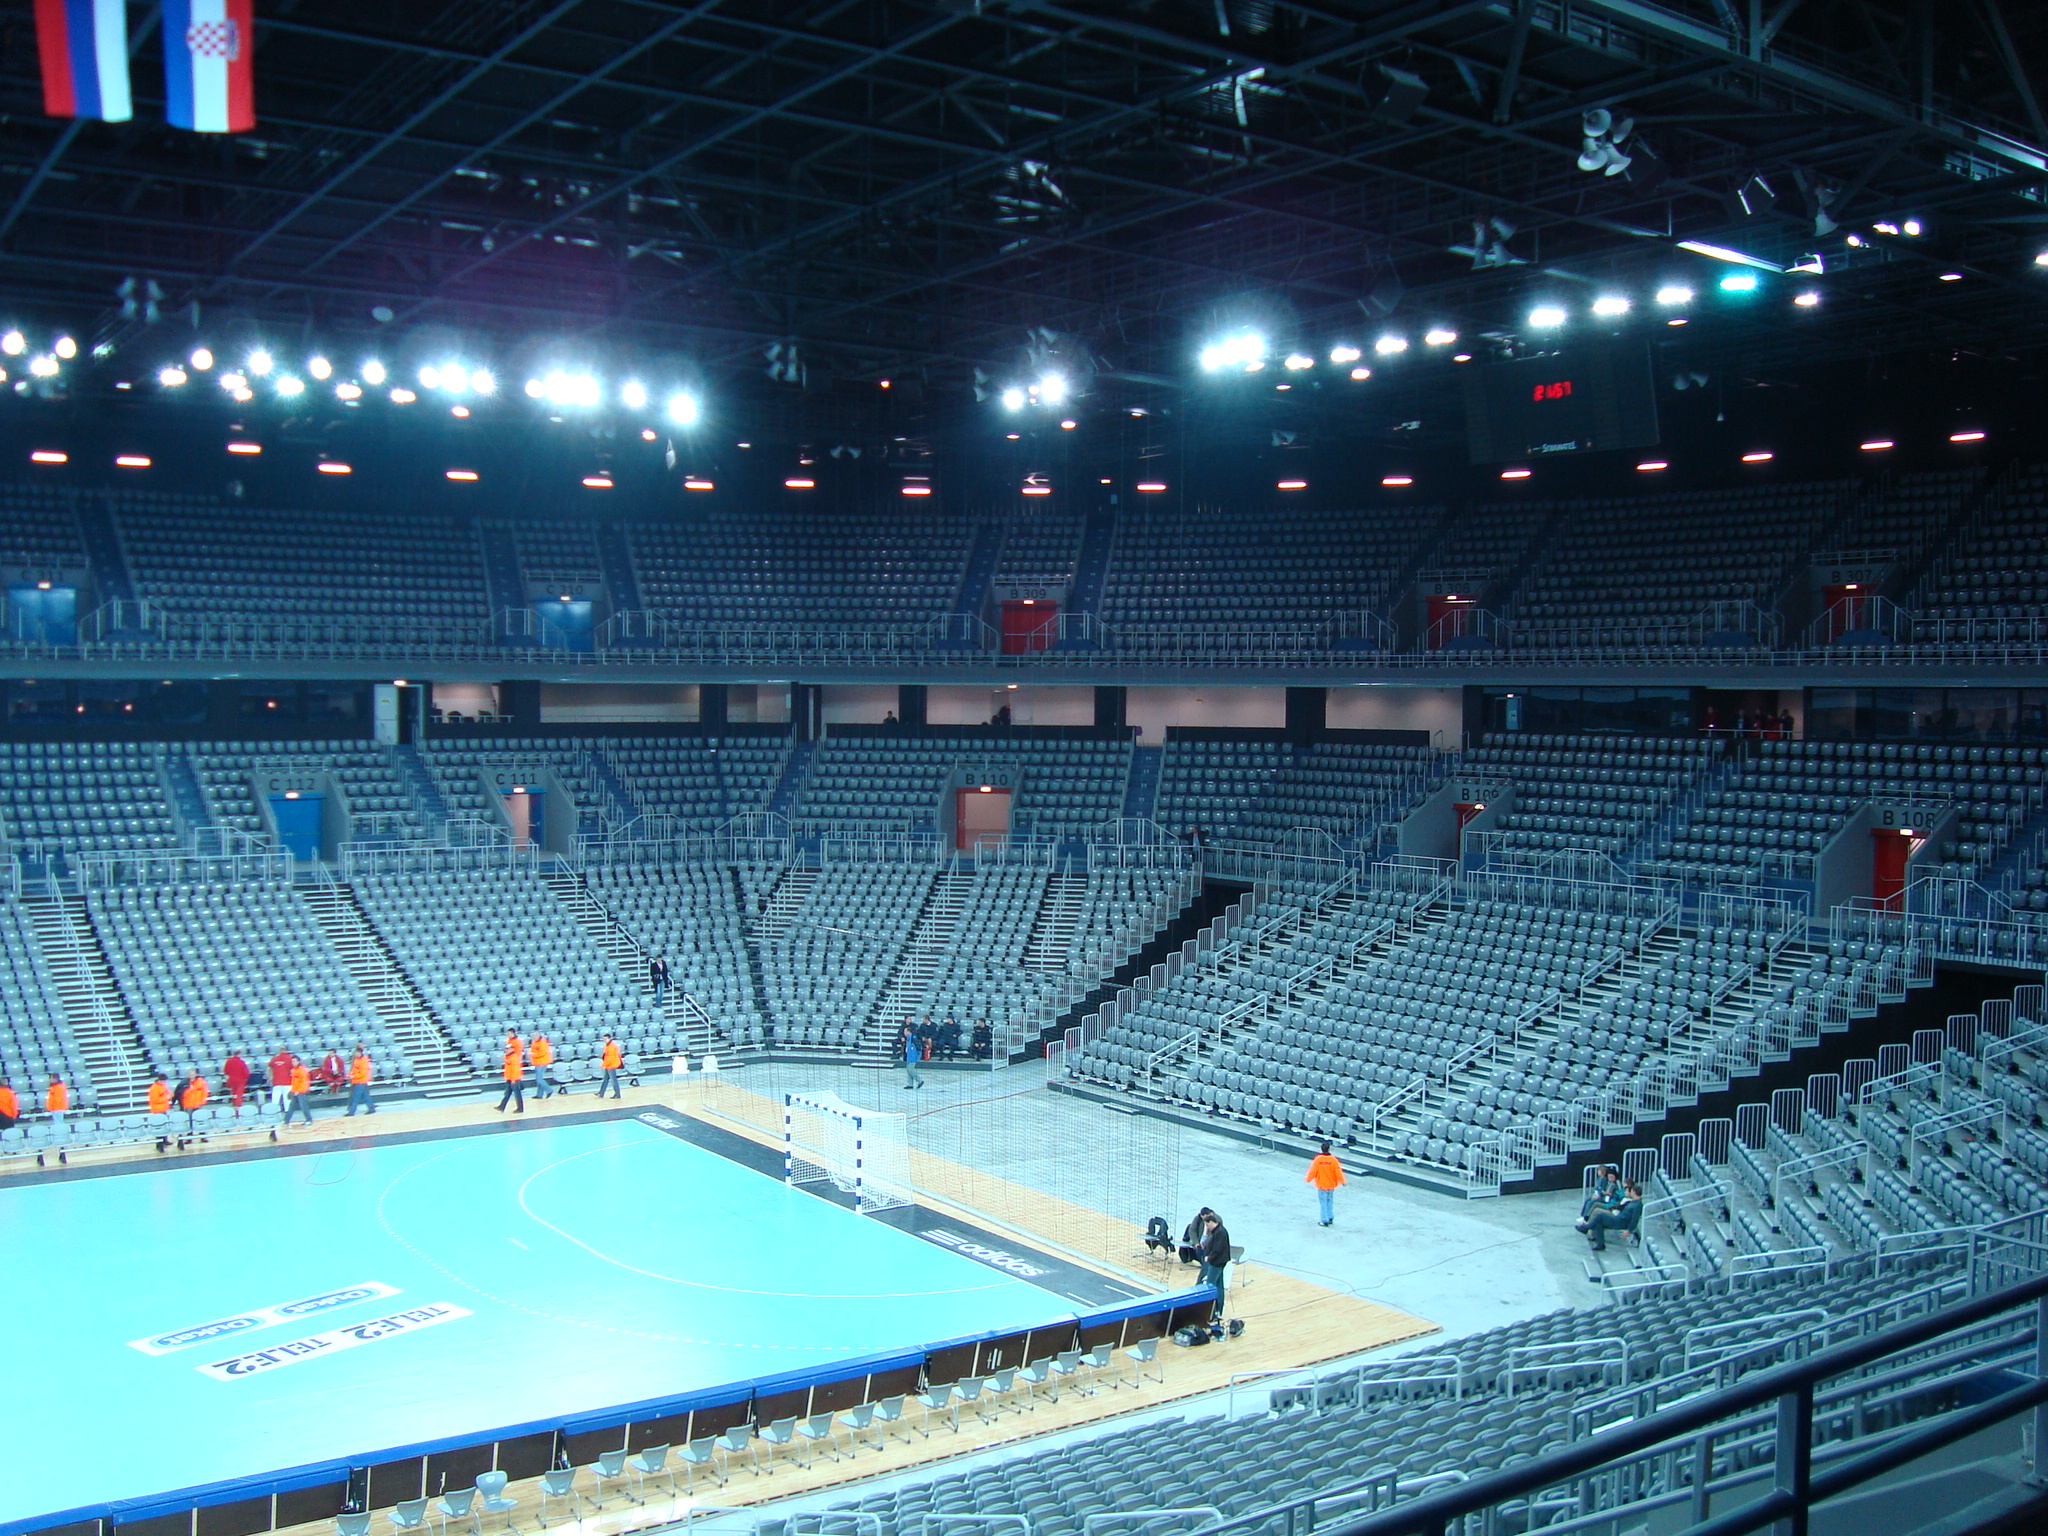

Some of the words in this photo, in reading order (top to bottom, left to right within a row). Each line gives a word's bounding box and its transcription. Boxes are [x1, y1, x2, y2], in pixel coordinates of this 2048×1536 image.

[1846, 570, 1872, 582] 307
[1022, 588, 1047, 599] 309
[268, 778, 280, 791] C
[286, 778, 315, 791] 112
[495, 773, 505, 785] C
[510, 773, 537, 785] 111
[965, 773, 975, 785] B
[980, 773, 1008, 785] 110
[1461, 788, 1470, 801] B
[1882, 810, 1894, 826] B
[1901, 811, 1935, 828] 108
[957, 1243, 1045, 1277] adidas
[286, 1289, 370, 1313] Dukat
[340, 1306, 450, 1339] TELE2
[162, 1319, 254, 1345] Dukat
[211, 1337, 333, 1375] TELE2
